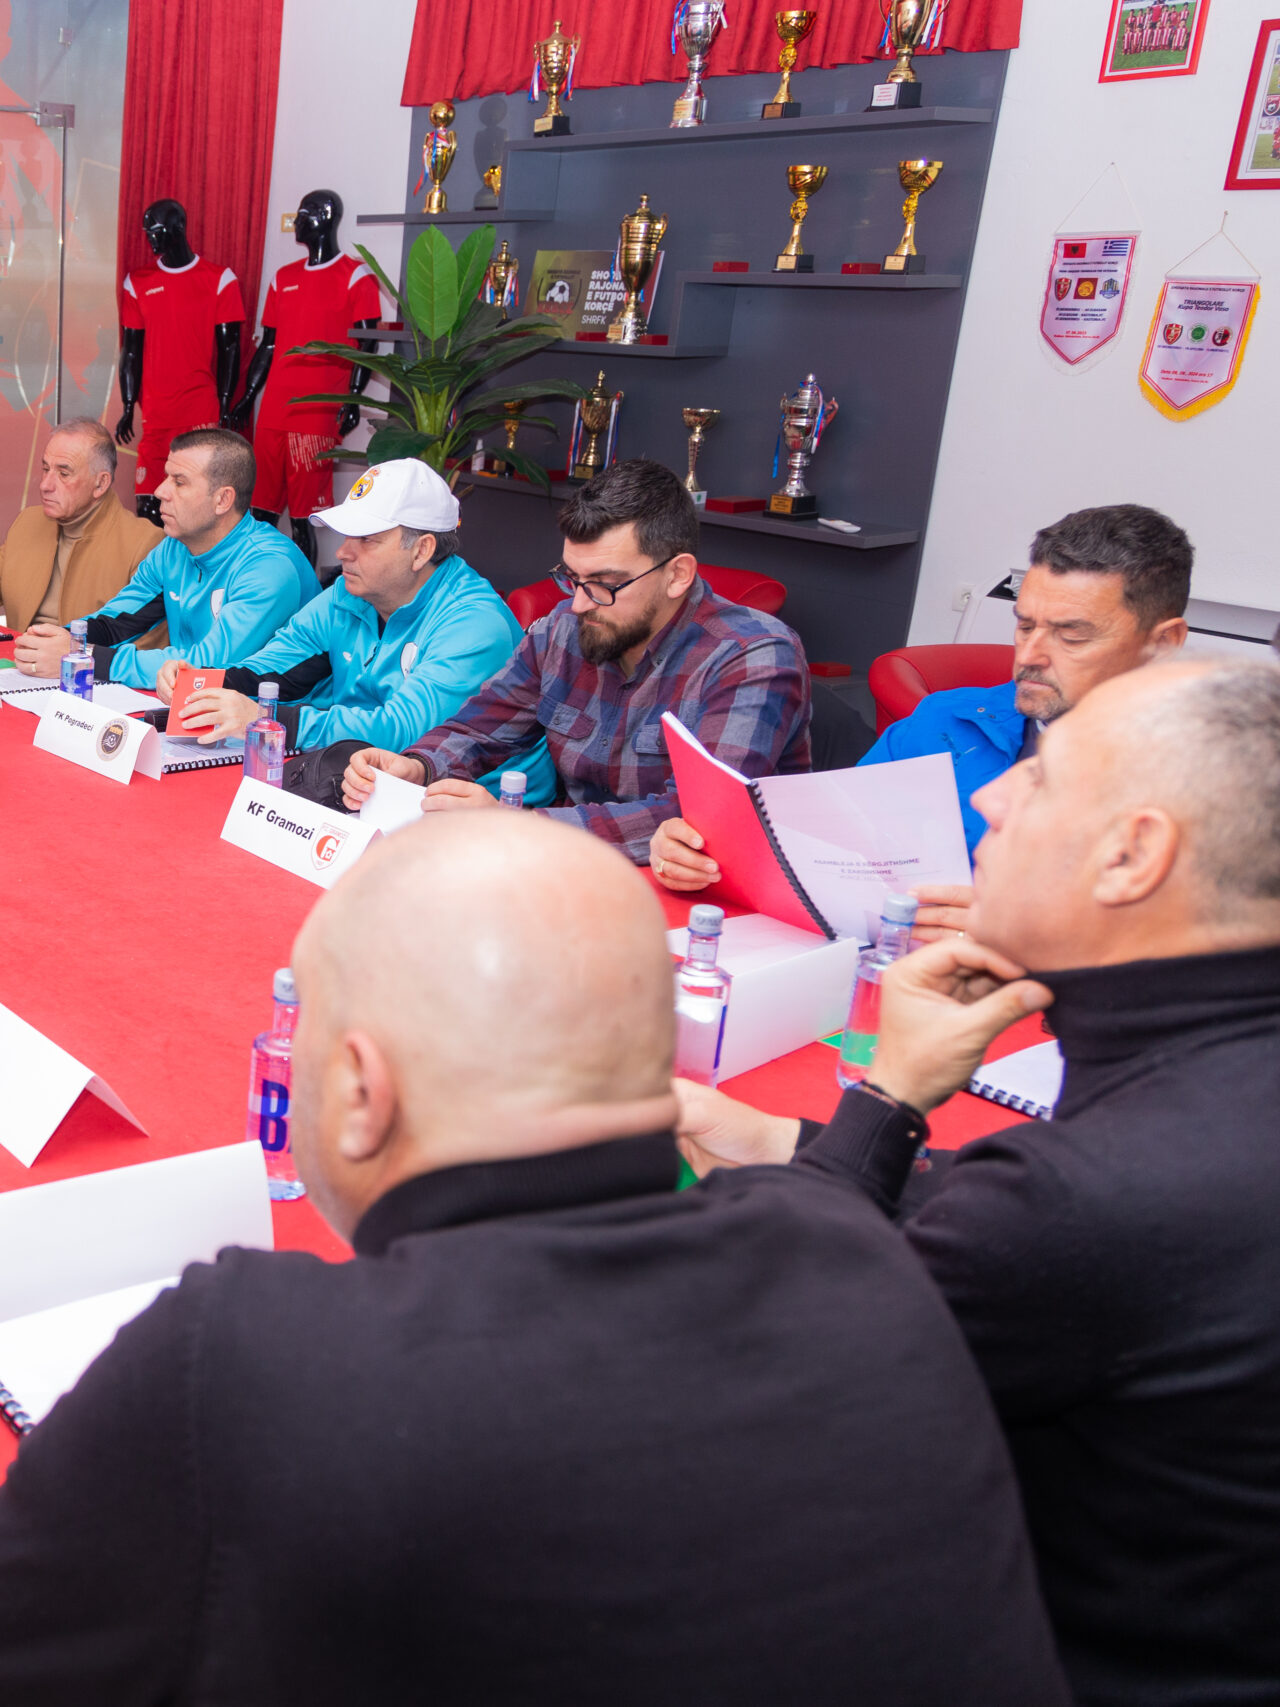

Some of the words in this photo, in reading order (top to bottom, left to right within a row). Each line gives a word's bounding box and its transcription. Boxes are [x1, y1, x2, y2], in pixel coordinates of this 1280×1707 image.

[586, 291, 593, 300] E
[581, 315, 608, 325] SHRFK
[54, 710, 64, 721] FK
[64, 714, 95, 732] Pogradeci
[246, 800, 266, 816] KF
[266, 809, 316, 841] Gramozi
